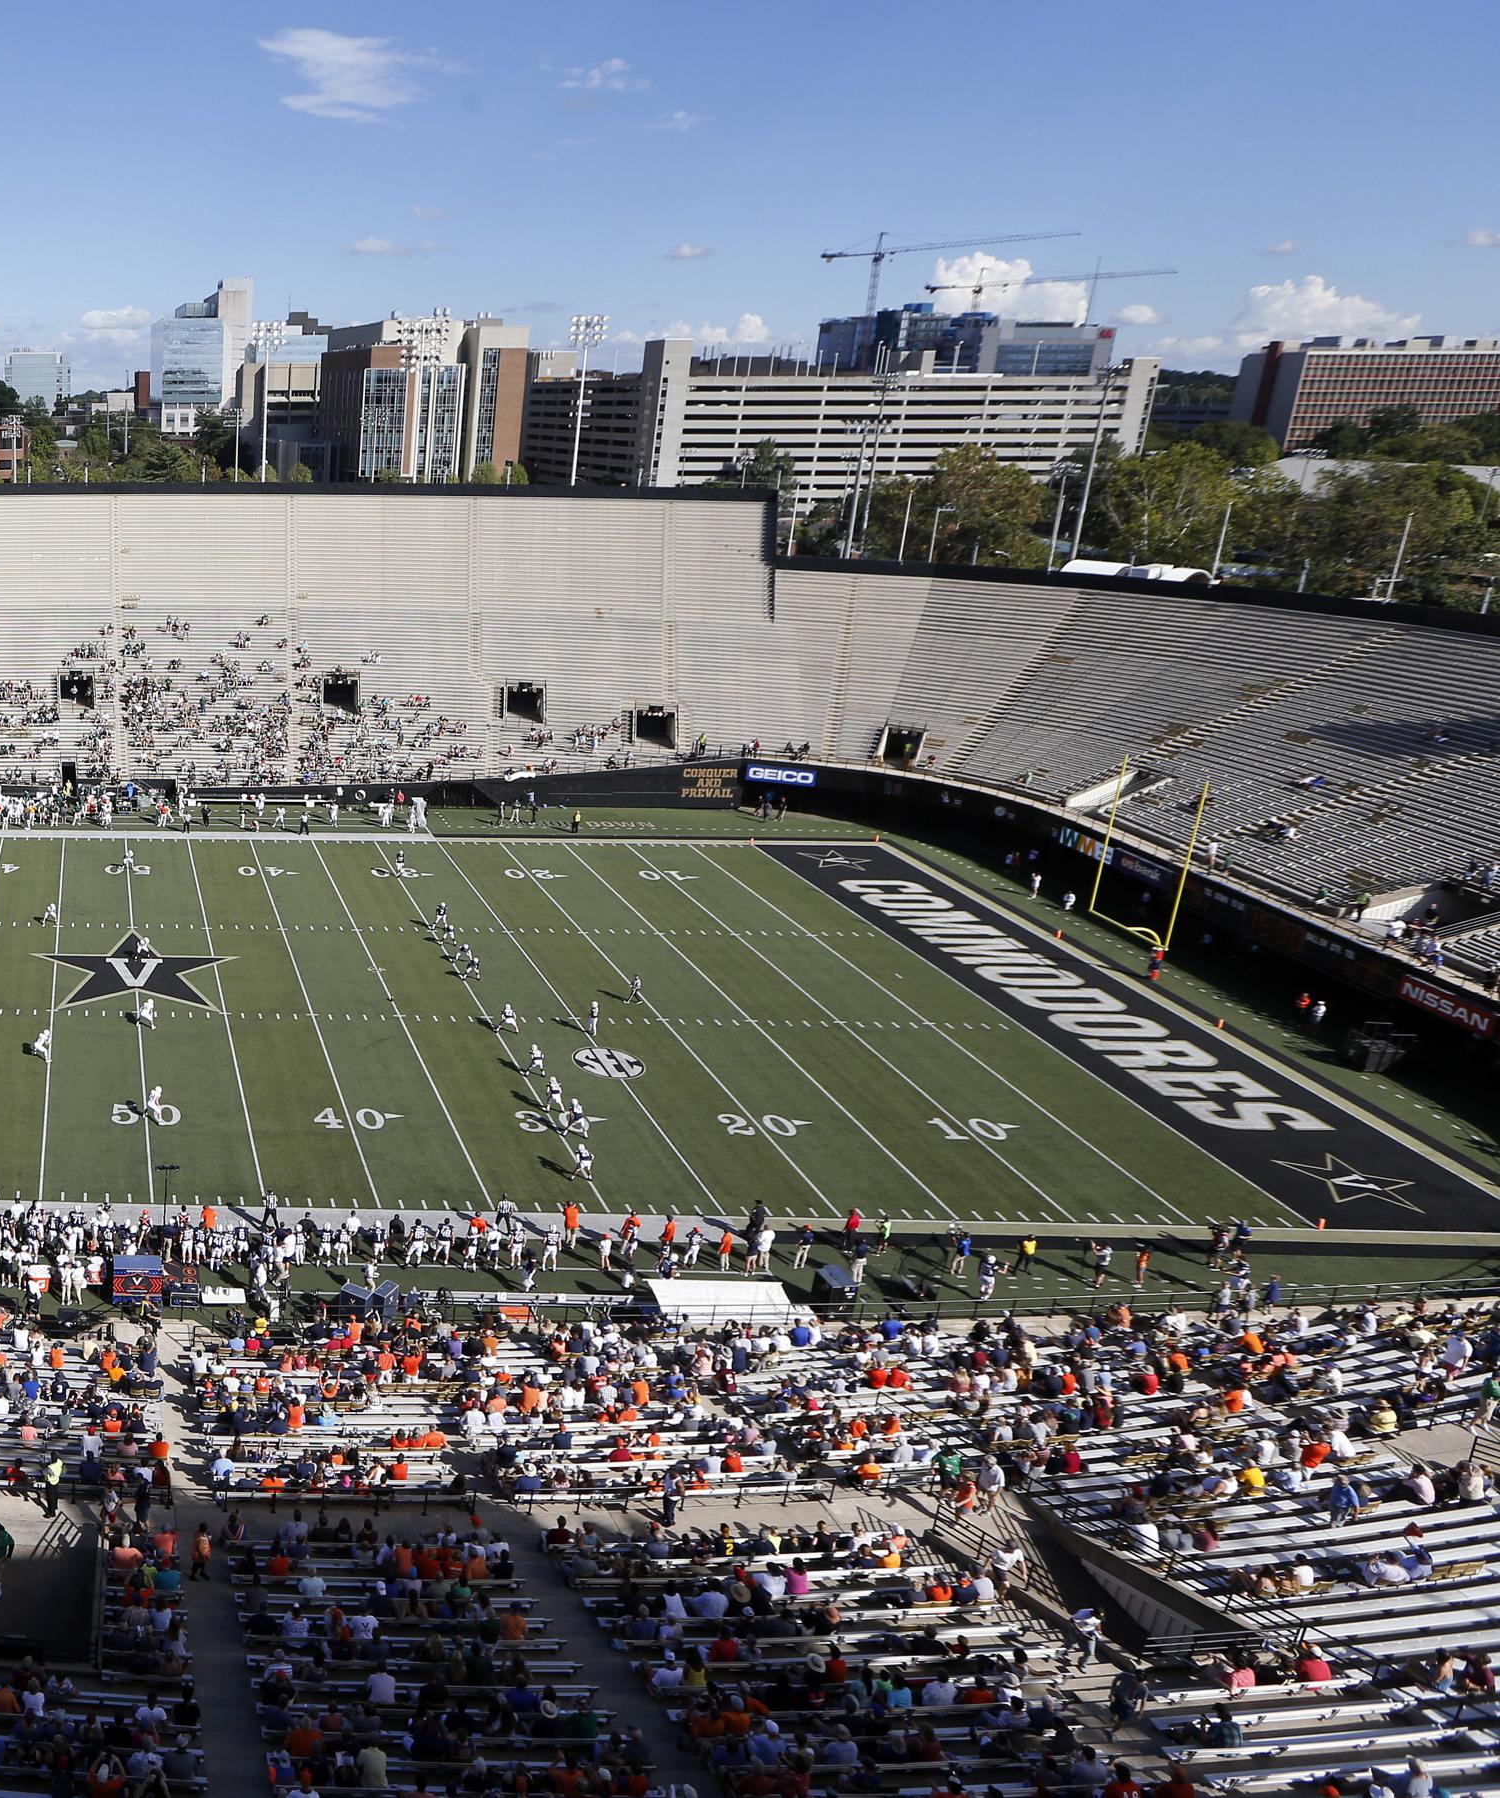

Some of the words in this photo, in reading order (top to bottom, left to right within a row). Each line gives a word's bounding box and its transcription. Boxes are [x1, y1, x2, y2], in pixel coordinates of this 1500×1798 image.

[682, 768, 738, 778] CONQUER
[696, 778, 722, 788] AND
[749, 767, 814, 784] GEICO
[681, 788, 734, 798] PREVAIL
[238, 865, 285, 877] 40
[504, 868, 554, 879] 20
[638, 870, 692, 881] 10
[105, 957, 163, 987] V
[838, 879, 1336, 1131] COMMODORES
[1402, 982, 1492, 1031] NISSAN
[574, 1049, 644, 1077] SEC
[111, 1103, 182, 1126] 50
[313, 1107, 386, 1130] 40
[717, 1113, 794, 1137] 20
[926, 1117, 1005, 1141] 10
